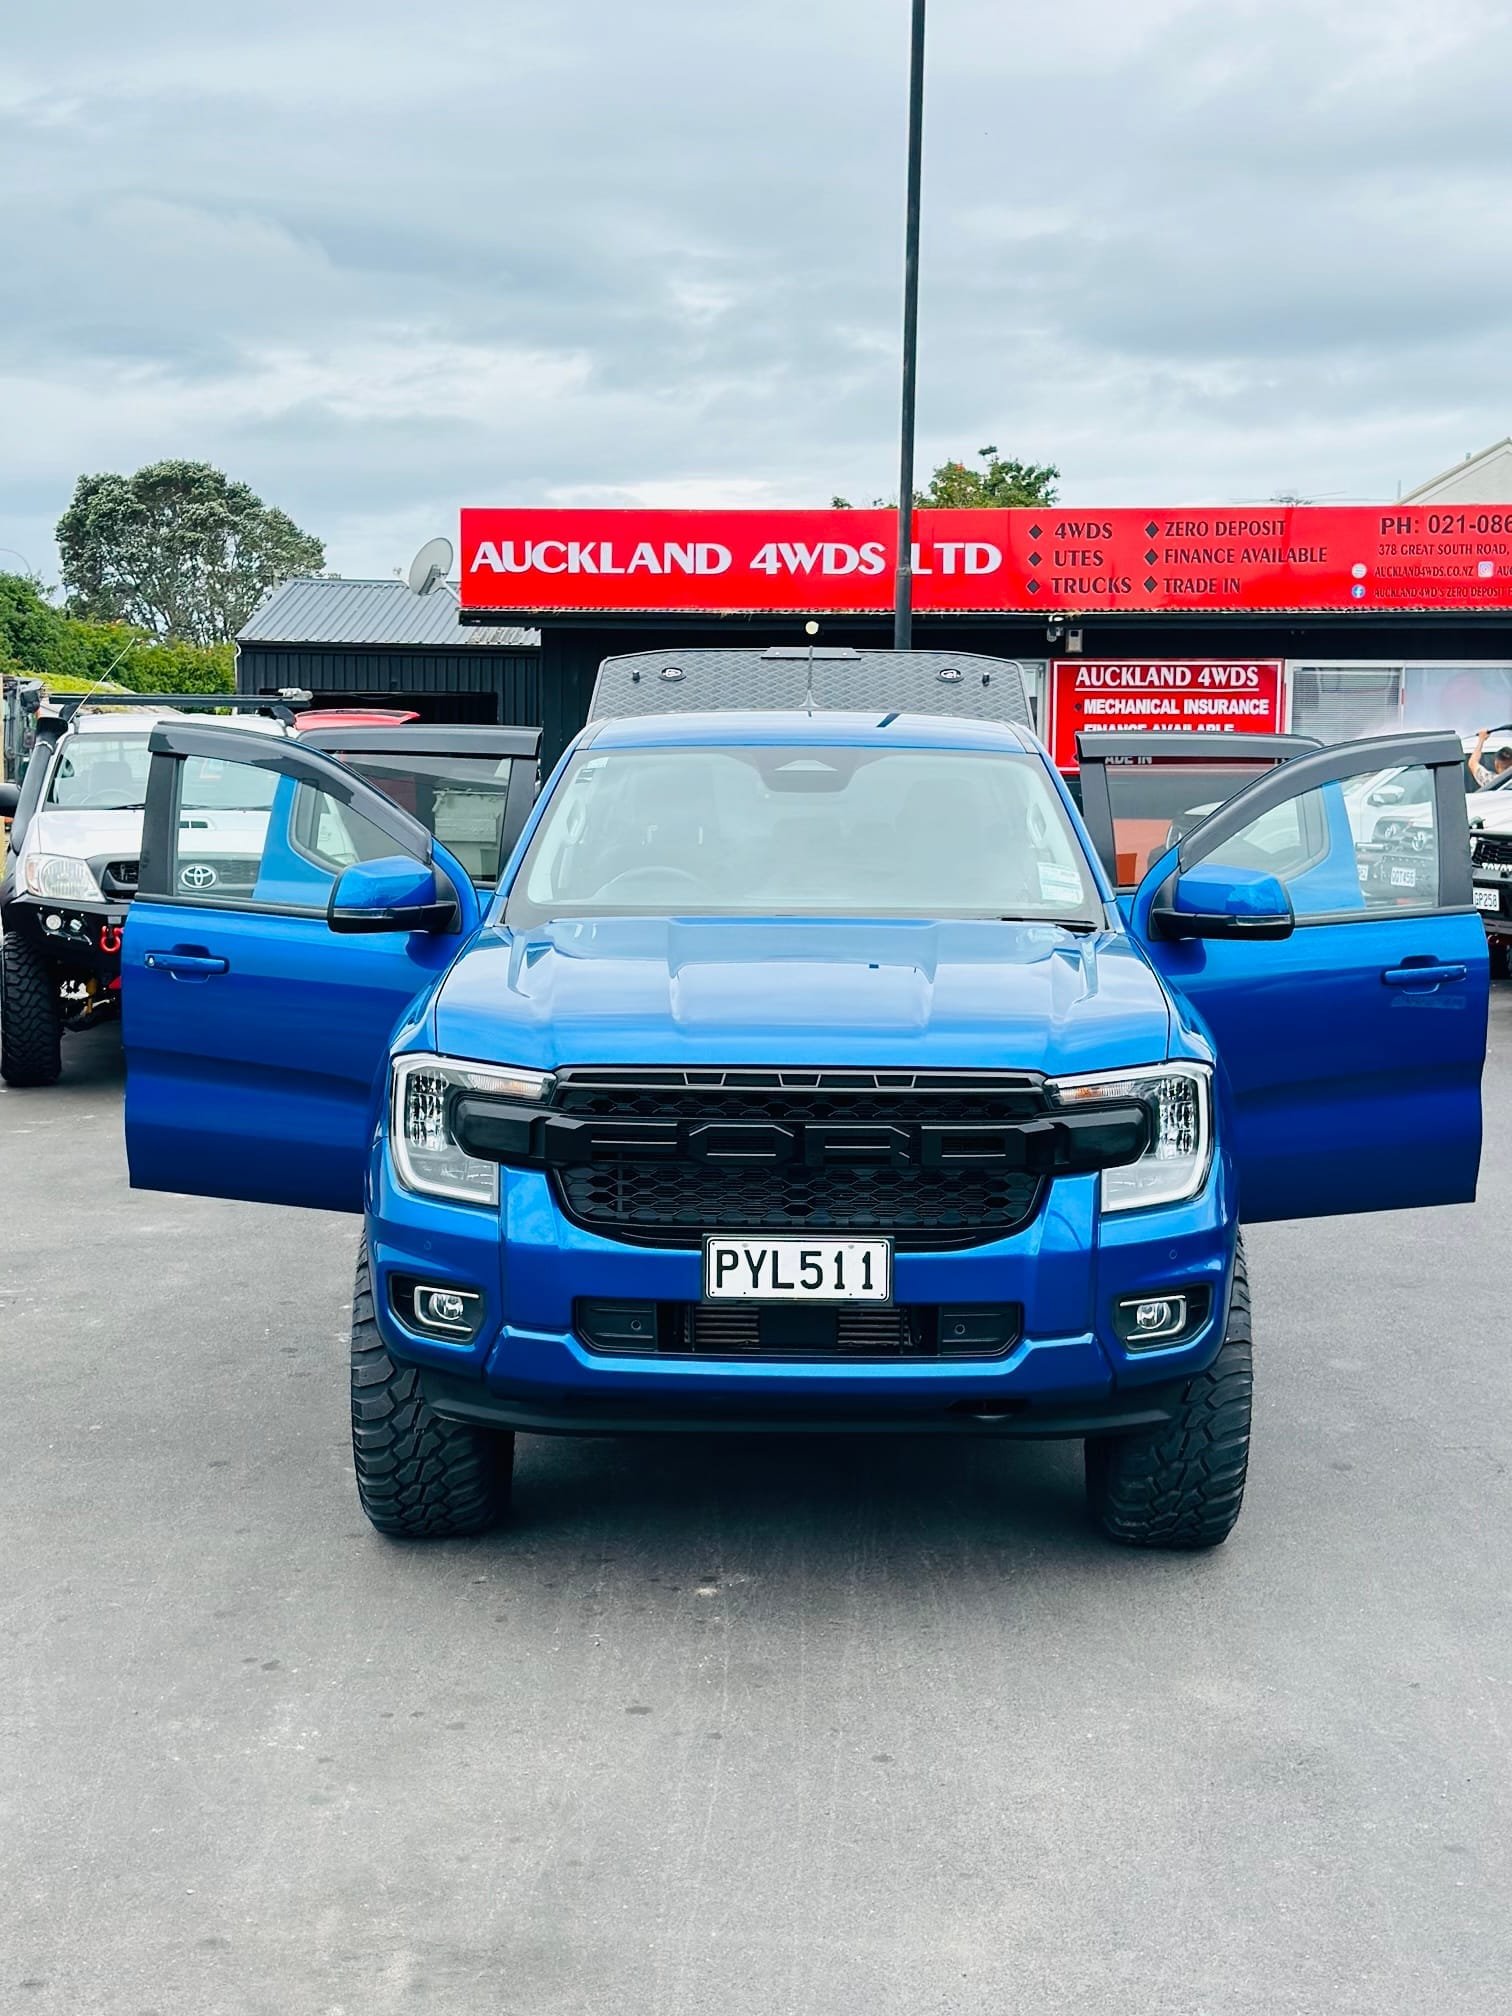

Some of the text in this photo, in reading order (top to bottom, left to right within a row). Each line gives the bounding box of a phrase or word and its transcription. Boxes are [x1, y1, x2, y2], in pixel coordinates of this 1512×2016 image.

[1055, 522, 1113, 539] 4WDS
[1165, 520, 1286, 537] ZERO DEPOSIT
[1381, 516, 1419, 535] PH:
[1164, 546, 1328, 564] FINANCE AVAILABLE
[1378, 544, 1397, 555] 378
[1400, 544, 1435, 555] GREAT
[1437, 543, 1473, 555] SOUTH
[470, 541, 1003, 576] AUCKLAND 4WDS LTD
[1054, 550, 1104, 566] UTES
[1051, 577, 1132, 594] TRUCKS
[1163, 577, 1241, 593] TRADE IN
[1447, 587, 1468, 598] ZERO
[1075, 666, 1260, 687] AUCKLAND 4WDS
[1083, 699, 1270, 715] MECHANICAL INSURANCE
[570, 1121, 1028, 1165] FORD
[716, 1249, 873, 1290] PYL511
